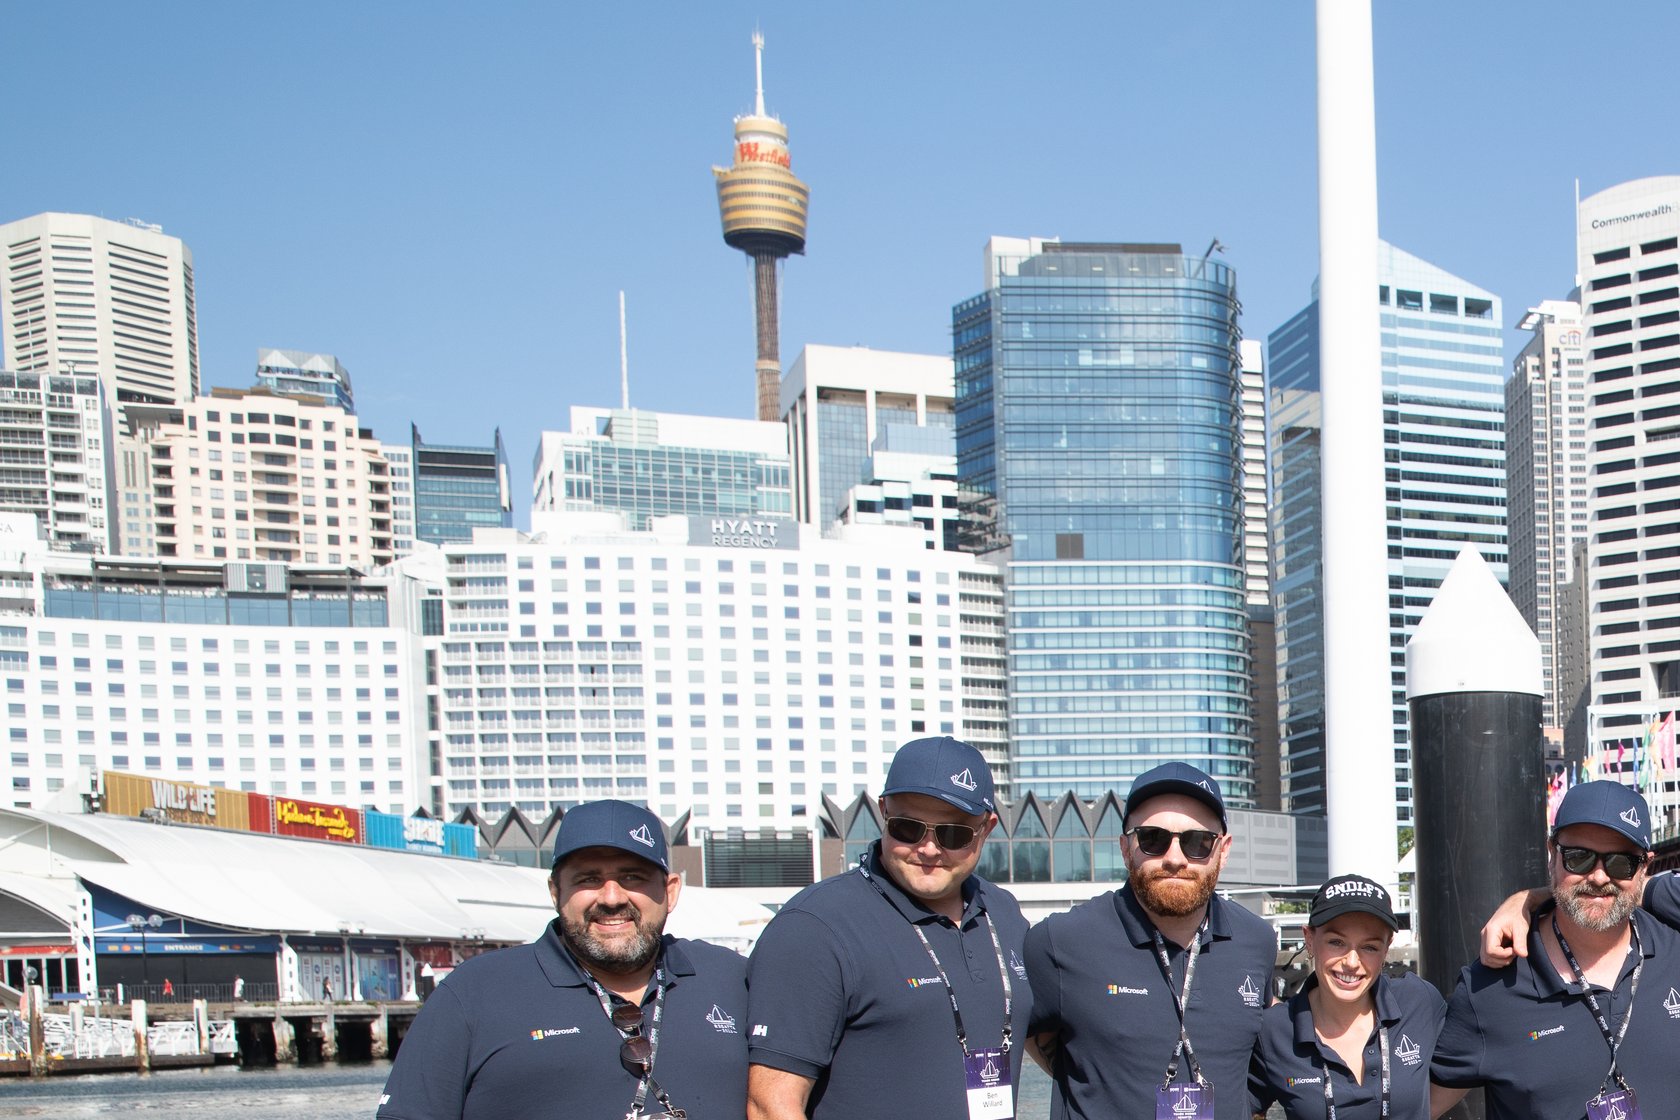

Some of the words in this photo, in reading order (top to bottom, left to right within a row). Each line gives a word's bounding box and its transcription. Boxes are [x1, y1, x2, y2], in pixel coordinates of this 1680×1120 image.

[711, 519, 778, 537] HYATT
[711, 536, 778, 549] REGENCY
[151, 779, 187, 810] WILD
[189, 786, 217, 816] LIFE
[1118, 985, 1149, 996] Microsoft
[544, 1026, 581, 1038] Microsoft
[1538, 1025, 1565, 1038] Microsoft
[1294, 1075, 1321, 1085] Microsoft
